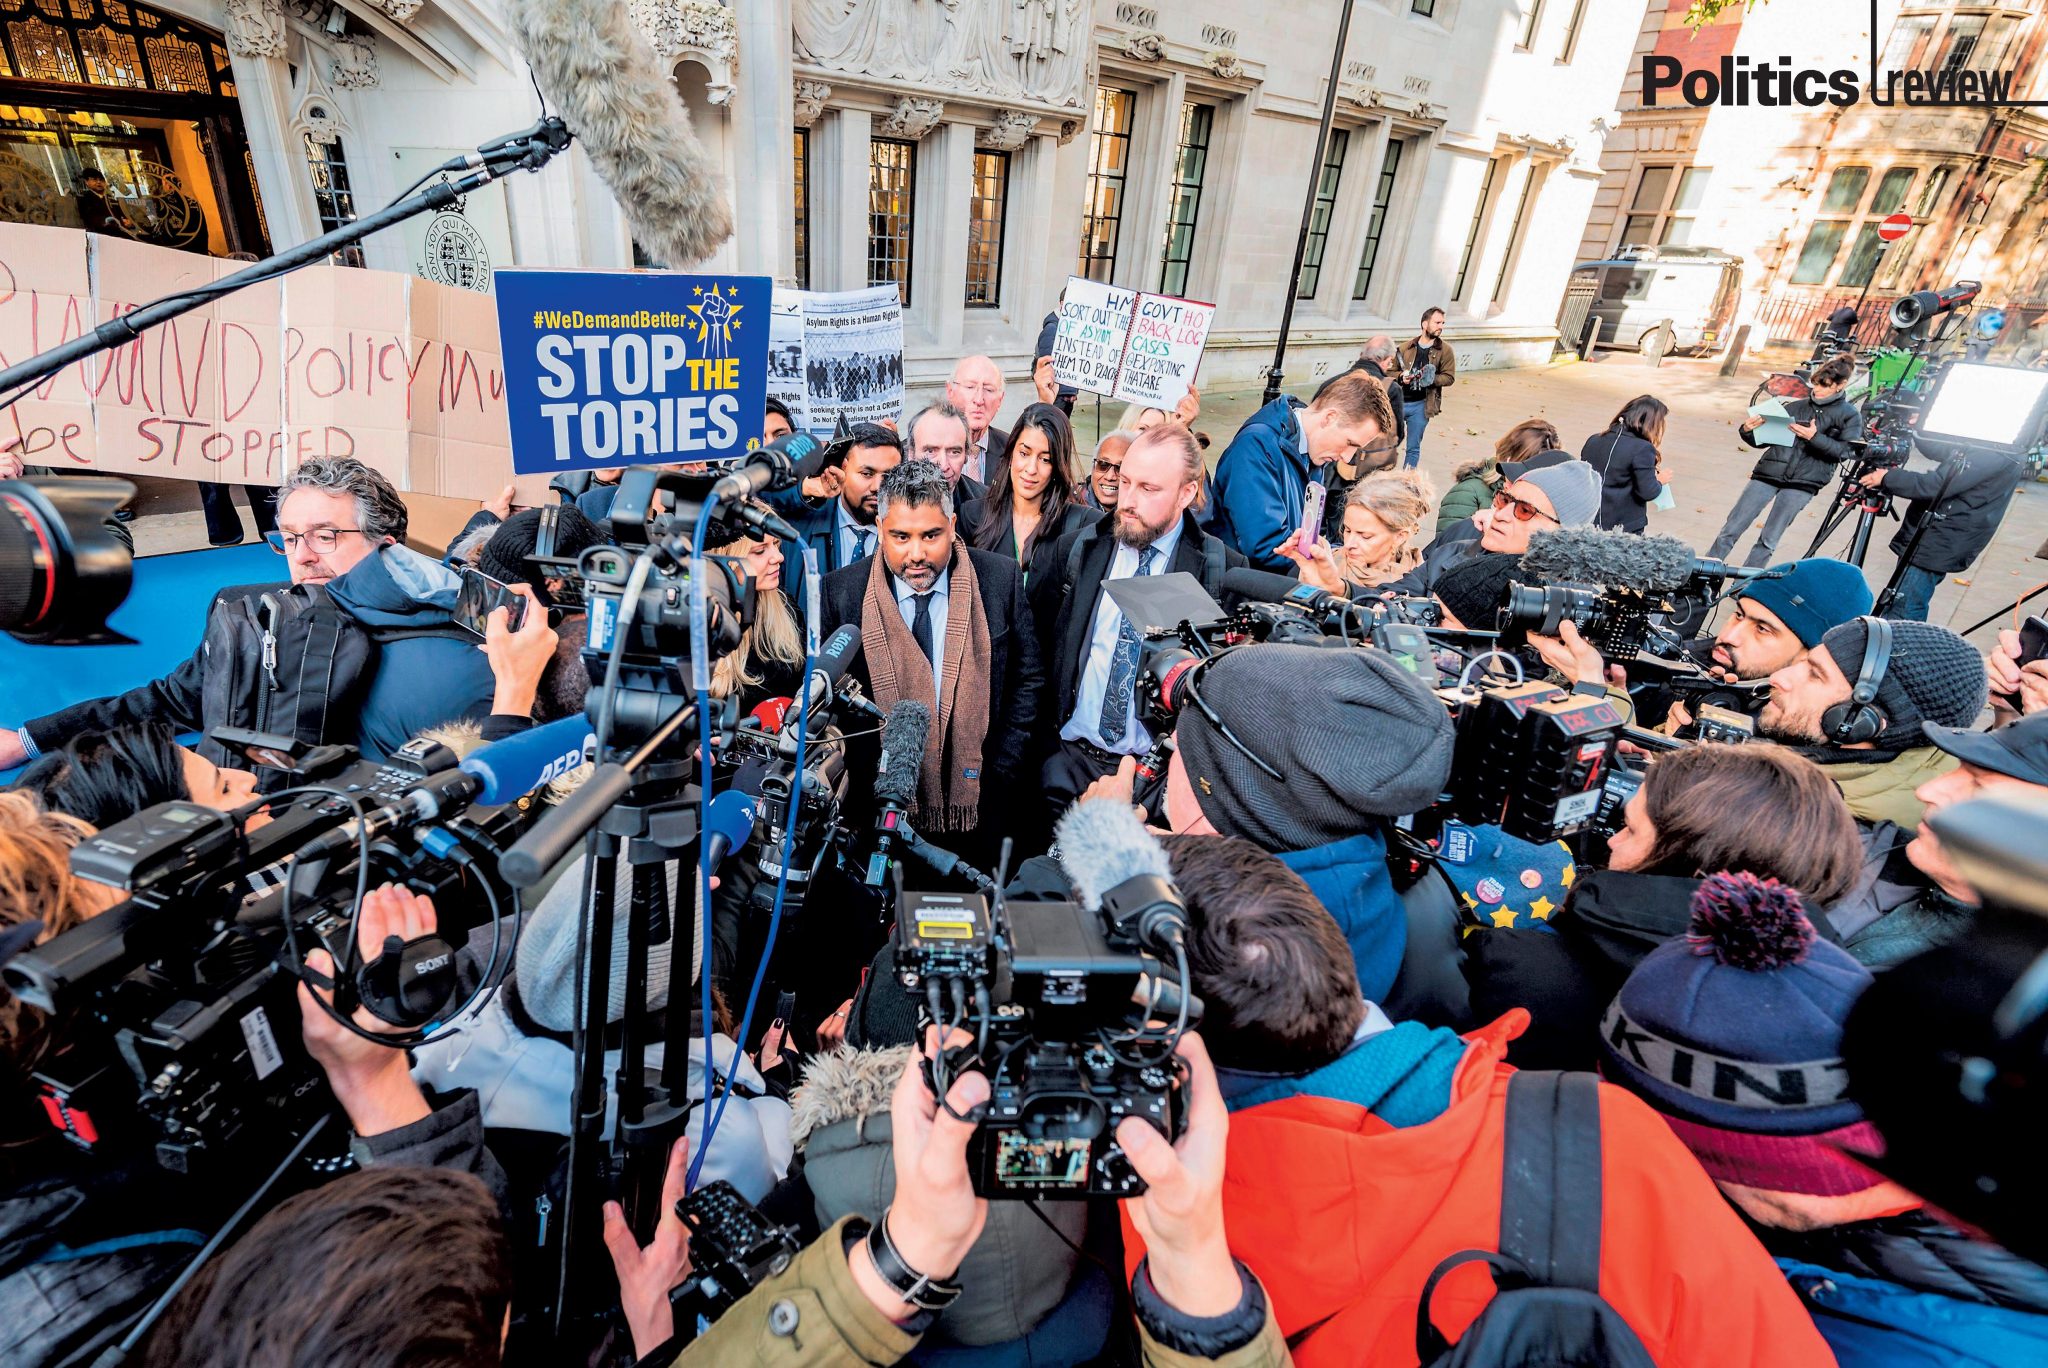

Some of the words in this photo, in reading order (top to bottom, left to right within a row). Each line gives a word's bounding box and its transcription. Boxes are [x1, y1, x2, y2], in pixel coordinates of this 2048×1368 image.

[428, 224, 441, 249] SOIT
[442, 219, 459, 230] QUI
[461, 224, 479, 247] MAL
[533, 310, 687, 329] #WeDemandBetter
[806, 317, 829, 328] Asylum
[829, 317, 849, 328] Rights
[850, 317, 856, 325] is
[862, 314, 881, 323] Human
[1061, 302, 1092, 320] SORT
[1092, 308, 1113, 327] OUT
[1115, 313, 1131, 331] THE
[1137, 317, 1174, 341] BACK
[1176, 327, 1204, 346] LOG
[1106, 292, 1134, 314] HM
[1142, 301, 1183, 323] GOVT
[1183, 310, 1204, 328] HO
[1058, 319, 1078, 335] OF
[1056, 335, 1103, 359] INSTEAD
[1109, 348, 1121, 364] OF
[536, 333, 686, 399] STOP
[686, 358, 740, 391] THE
[1079, 358, 1091, 374] TO
[781, 392, 801, 402] Rights
[810, 406, 835, 415] seeking
[857, 403, 864, 412] is
[865, 403, 875, 412] not
[882, 400, 900, 410] CRIME
[11, 403, 91, 463] be
[540, 394, 739, 460] TORIES
[530, 749, 580, 790] AFP
[415, 954, 448, 974] SONY
[1603, 1010, 1848, 1105] KIN
